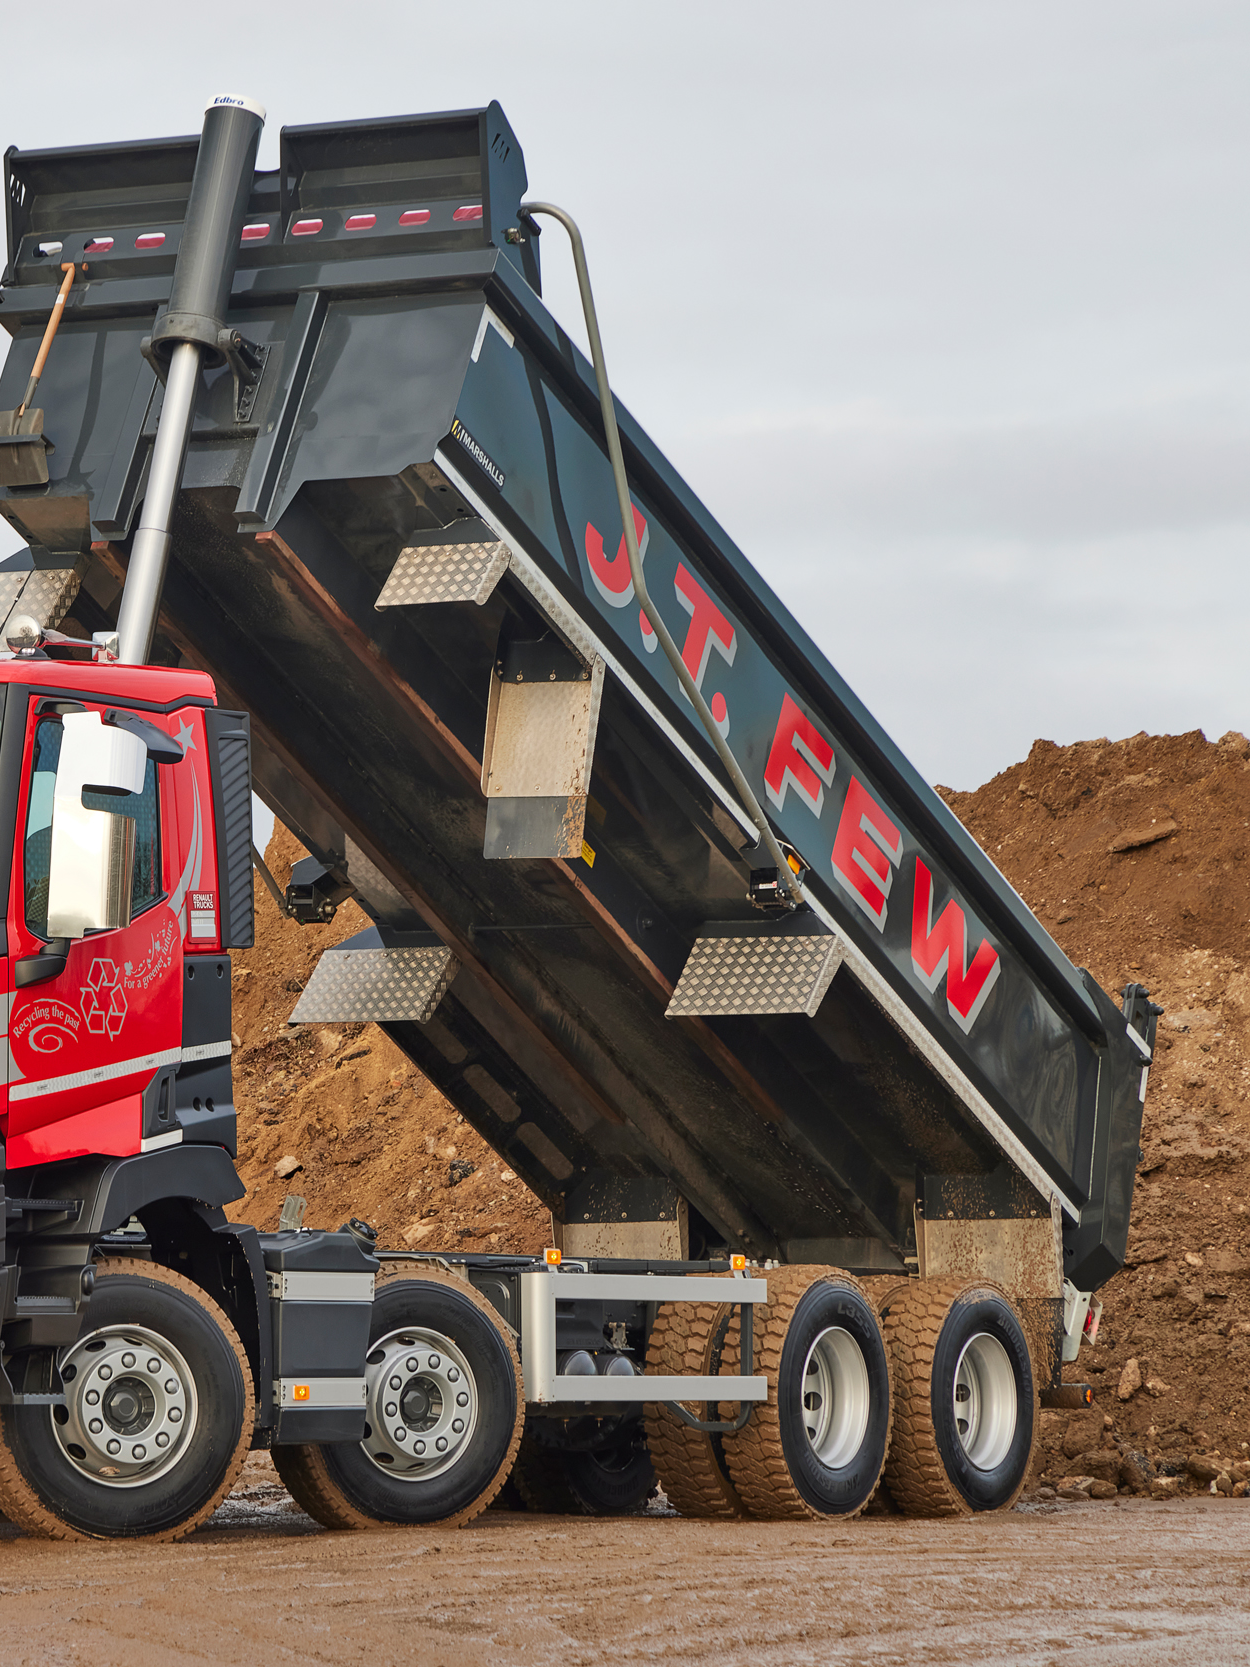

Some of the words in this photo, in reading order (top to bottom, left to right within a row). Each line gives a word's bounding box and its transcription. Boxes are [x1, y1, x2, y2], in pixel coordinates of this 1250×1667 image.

[213, 96, 244, 106] Edbro
[462, 432, 505, 487] MARSHALLS
[764, 692, 1000, 1034] FEW
[192, 893, 214, 902] RENAULT
[193, 901, 214, 909] TRUCKS
[123, 976, 136, 989] For
[136, 979, 142, 989] a
[142, 955, 164, 990] greener
[161, 920, 174, 956] future
[12, 1006, 51, 1039] Recycling
[51, 1004, 65, 1020] the
[64, 1013, 80, 1032] past
[837, 1300, 871, 1339] L355
